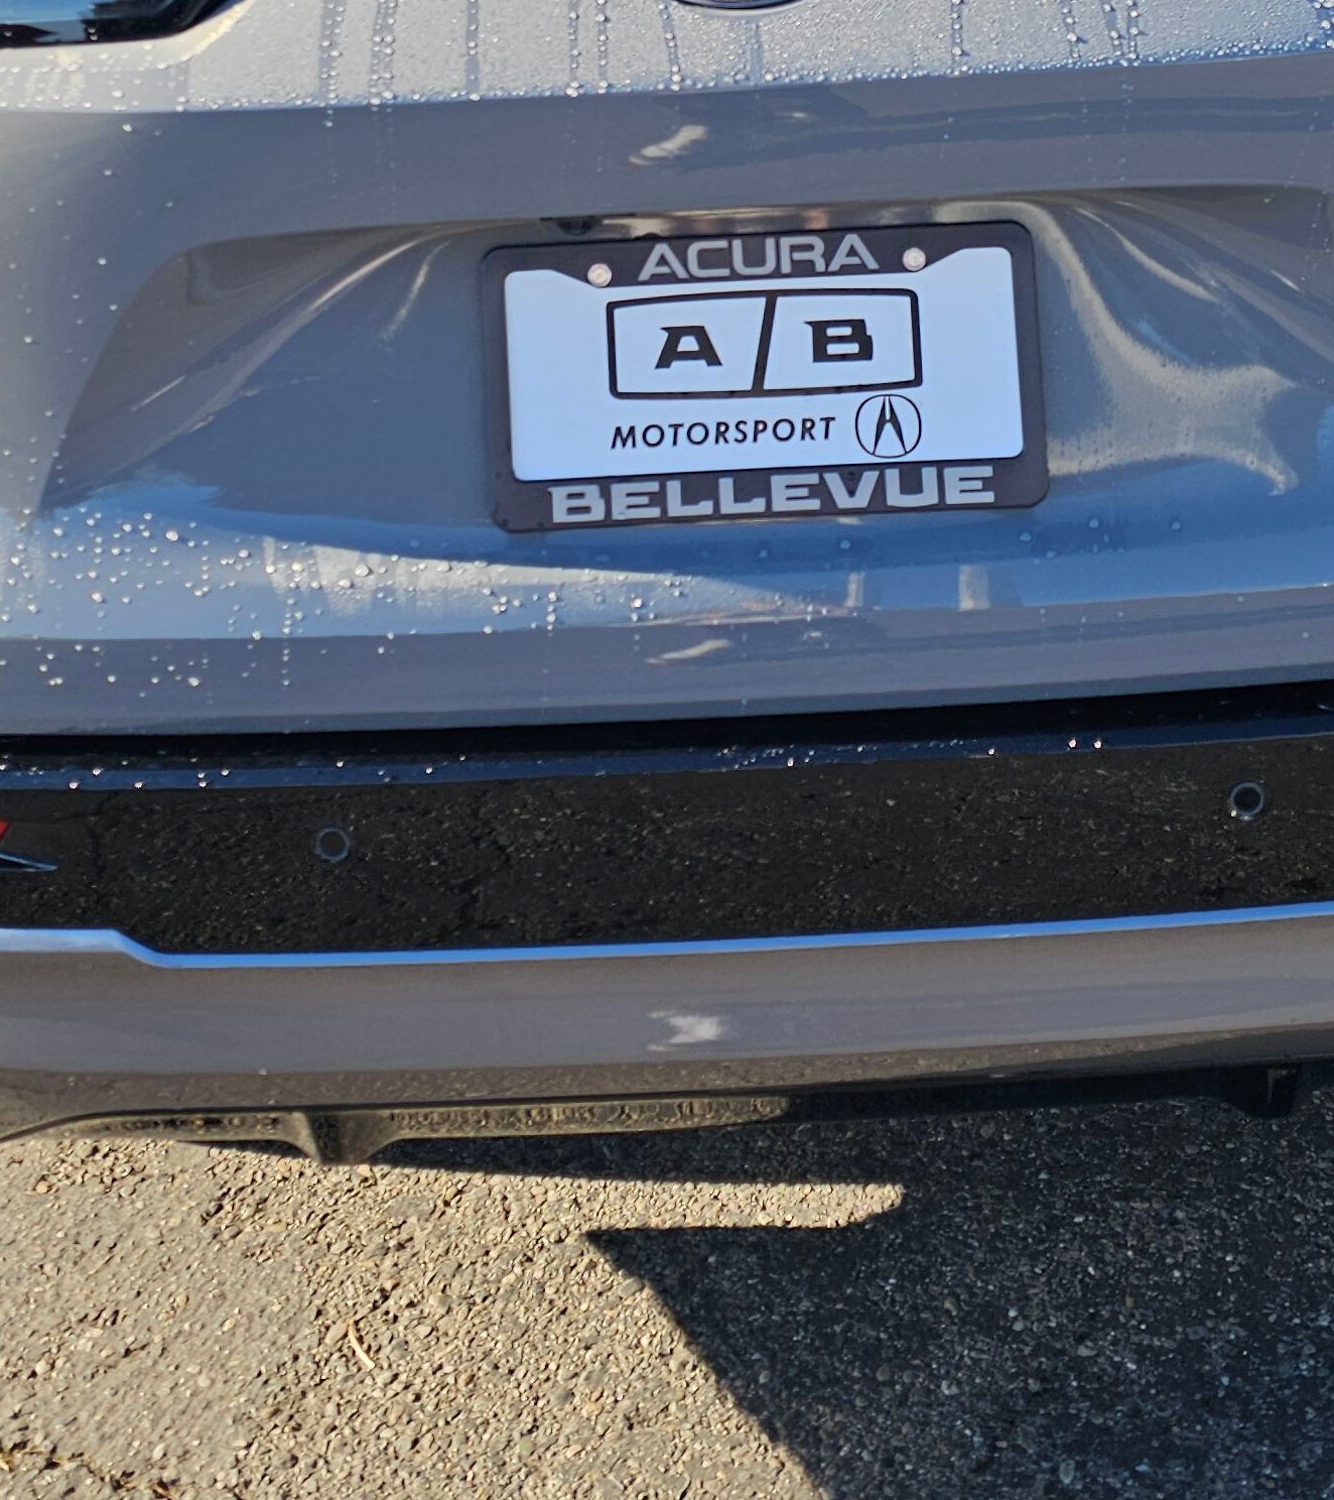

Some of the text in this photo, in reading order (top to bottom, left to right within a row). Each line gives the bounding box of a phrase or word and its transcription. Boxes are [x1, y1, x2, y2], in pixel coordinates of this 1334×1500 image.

[637, 233, 880, 282] ACURA
[655, 319, 873, 369] A B
[611, 417, 836, 449] MOTORSPORT
[548, 466, 995, 524] BELLEVUE
